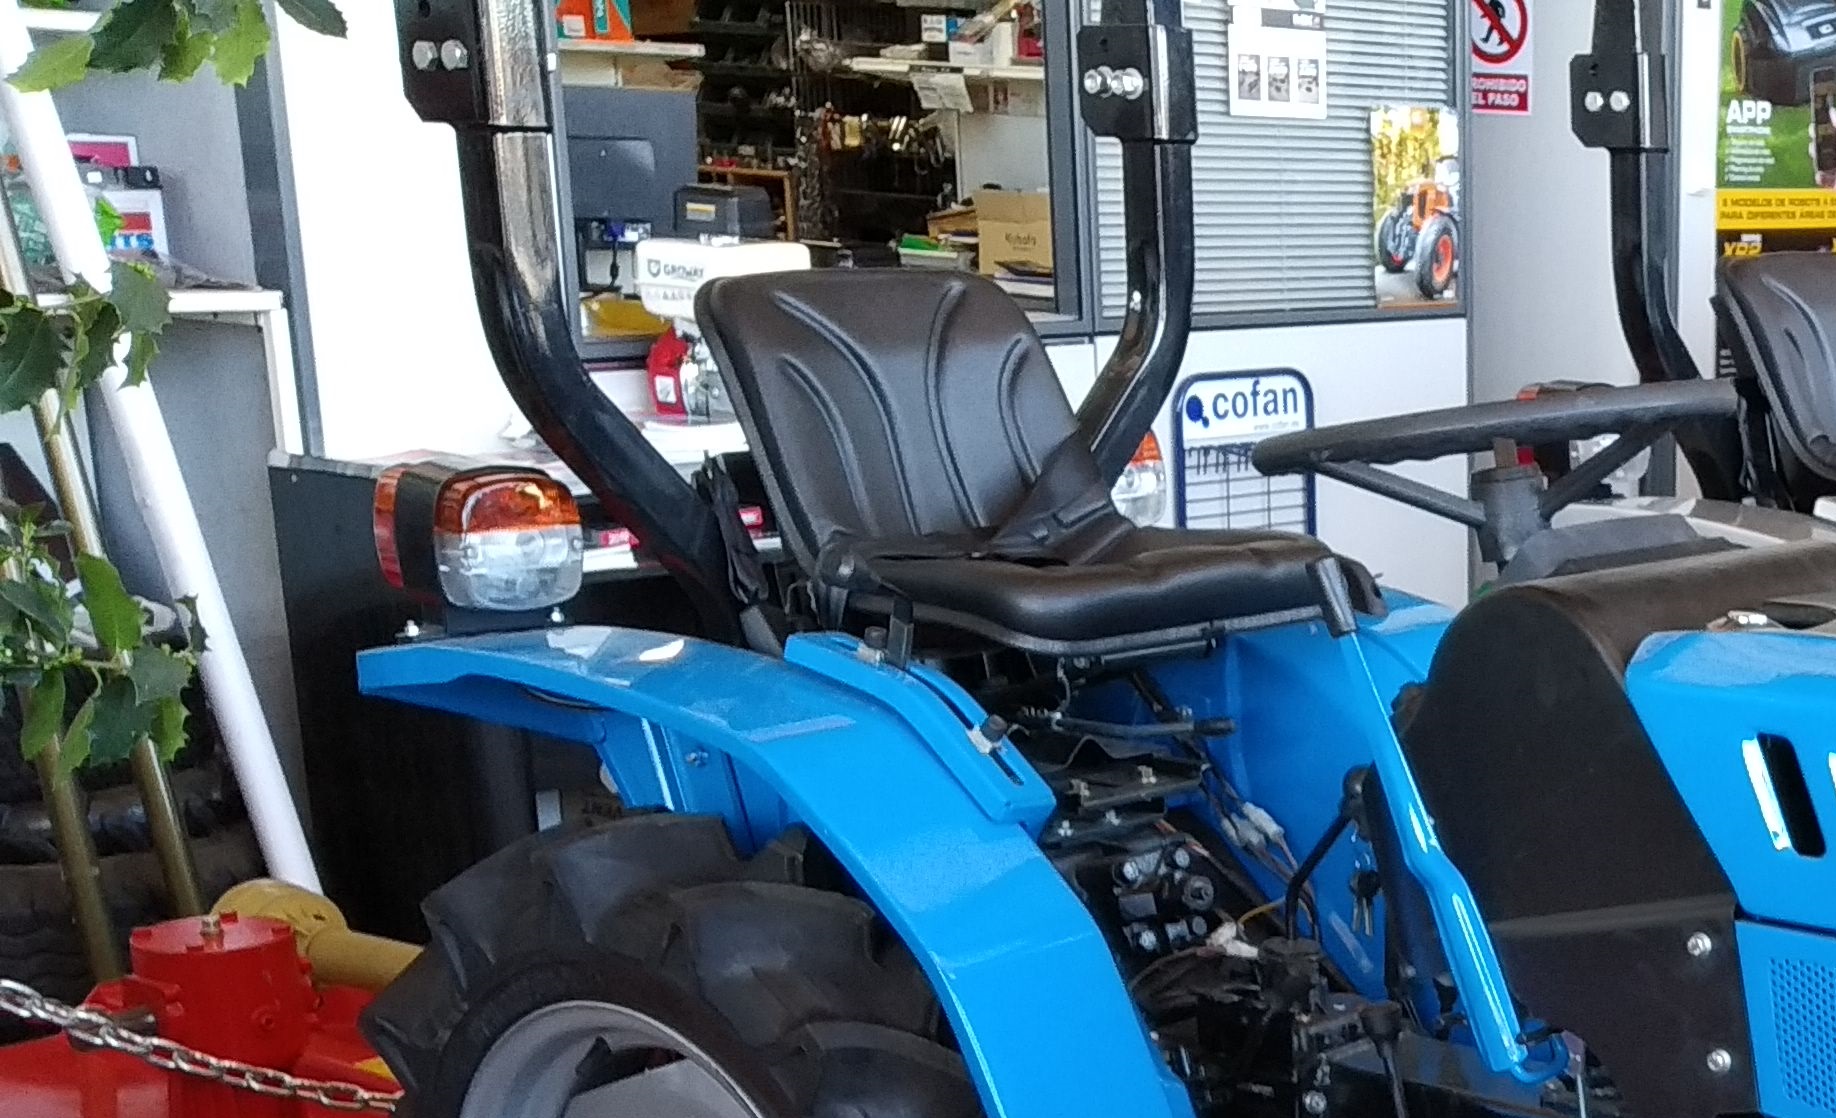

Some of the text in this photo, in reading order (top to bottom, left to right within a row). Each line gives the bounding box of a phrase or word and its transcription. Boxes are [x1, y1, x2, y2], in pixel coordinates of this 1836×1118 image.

[1487, 92, 1519, 107] PASO
[1726, 99, 1772, 124] APP
[1212, 378, 1298, 421] cofan
